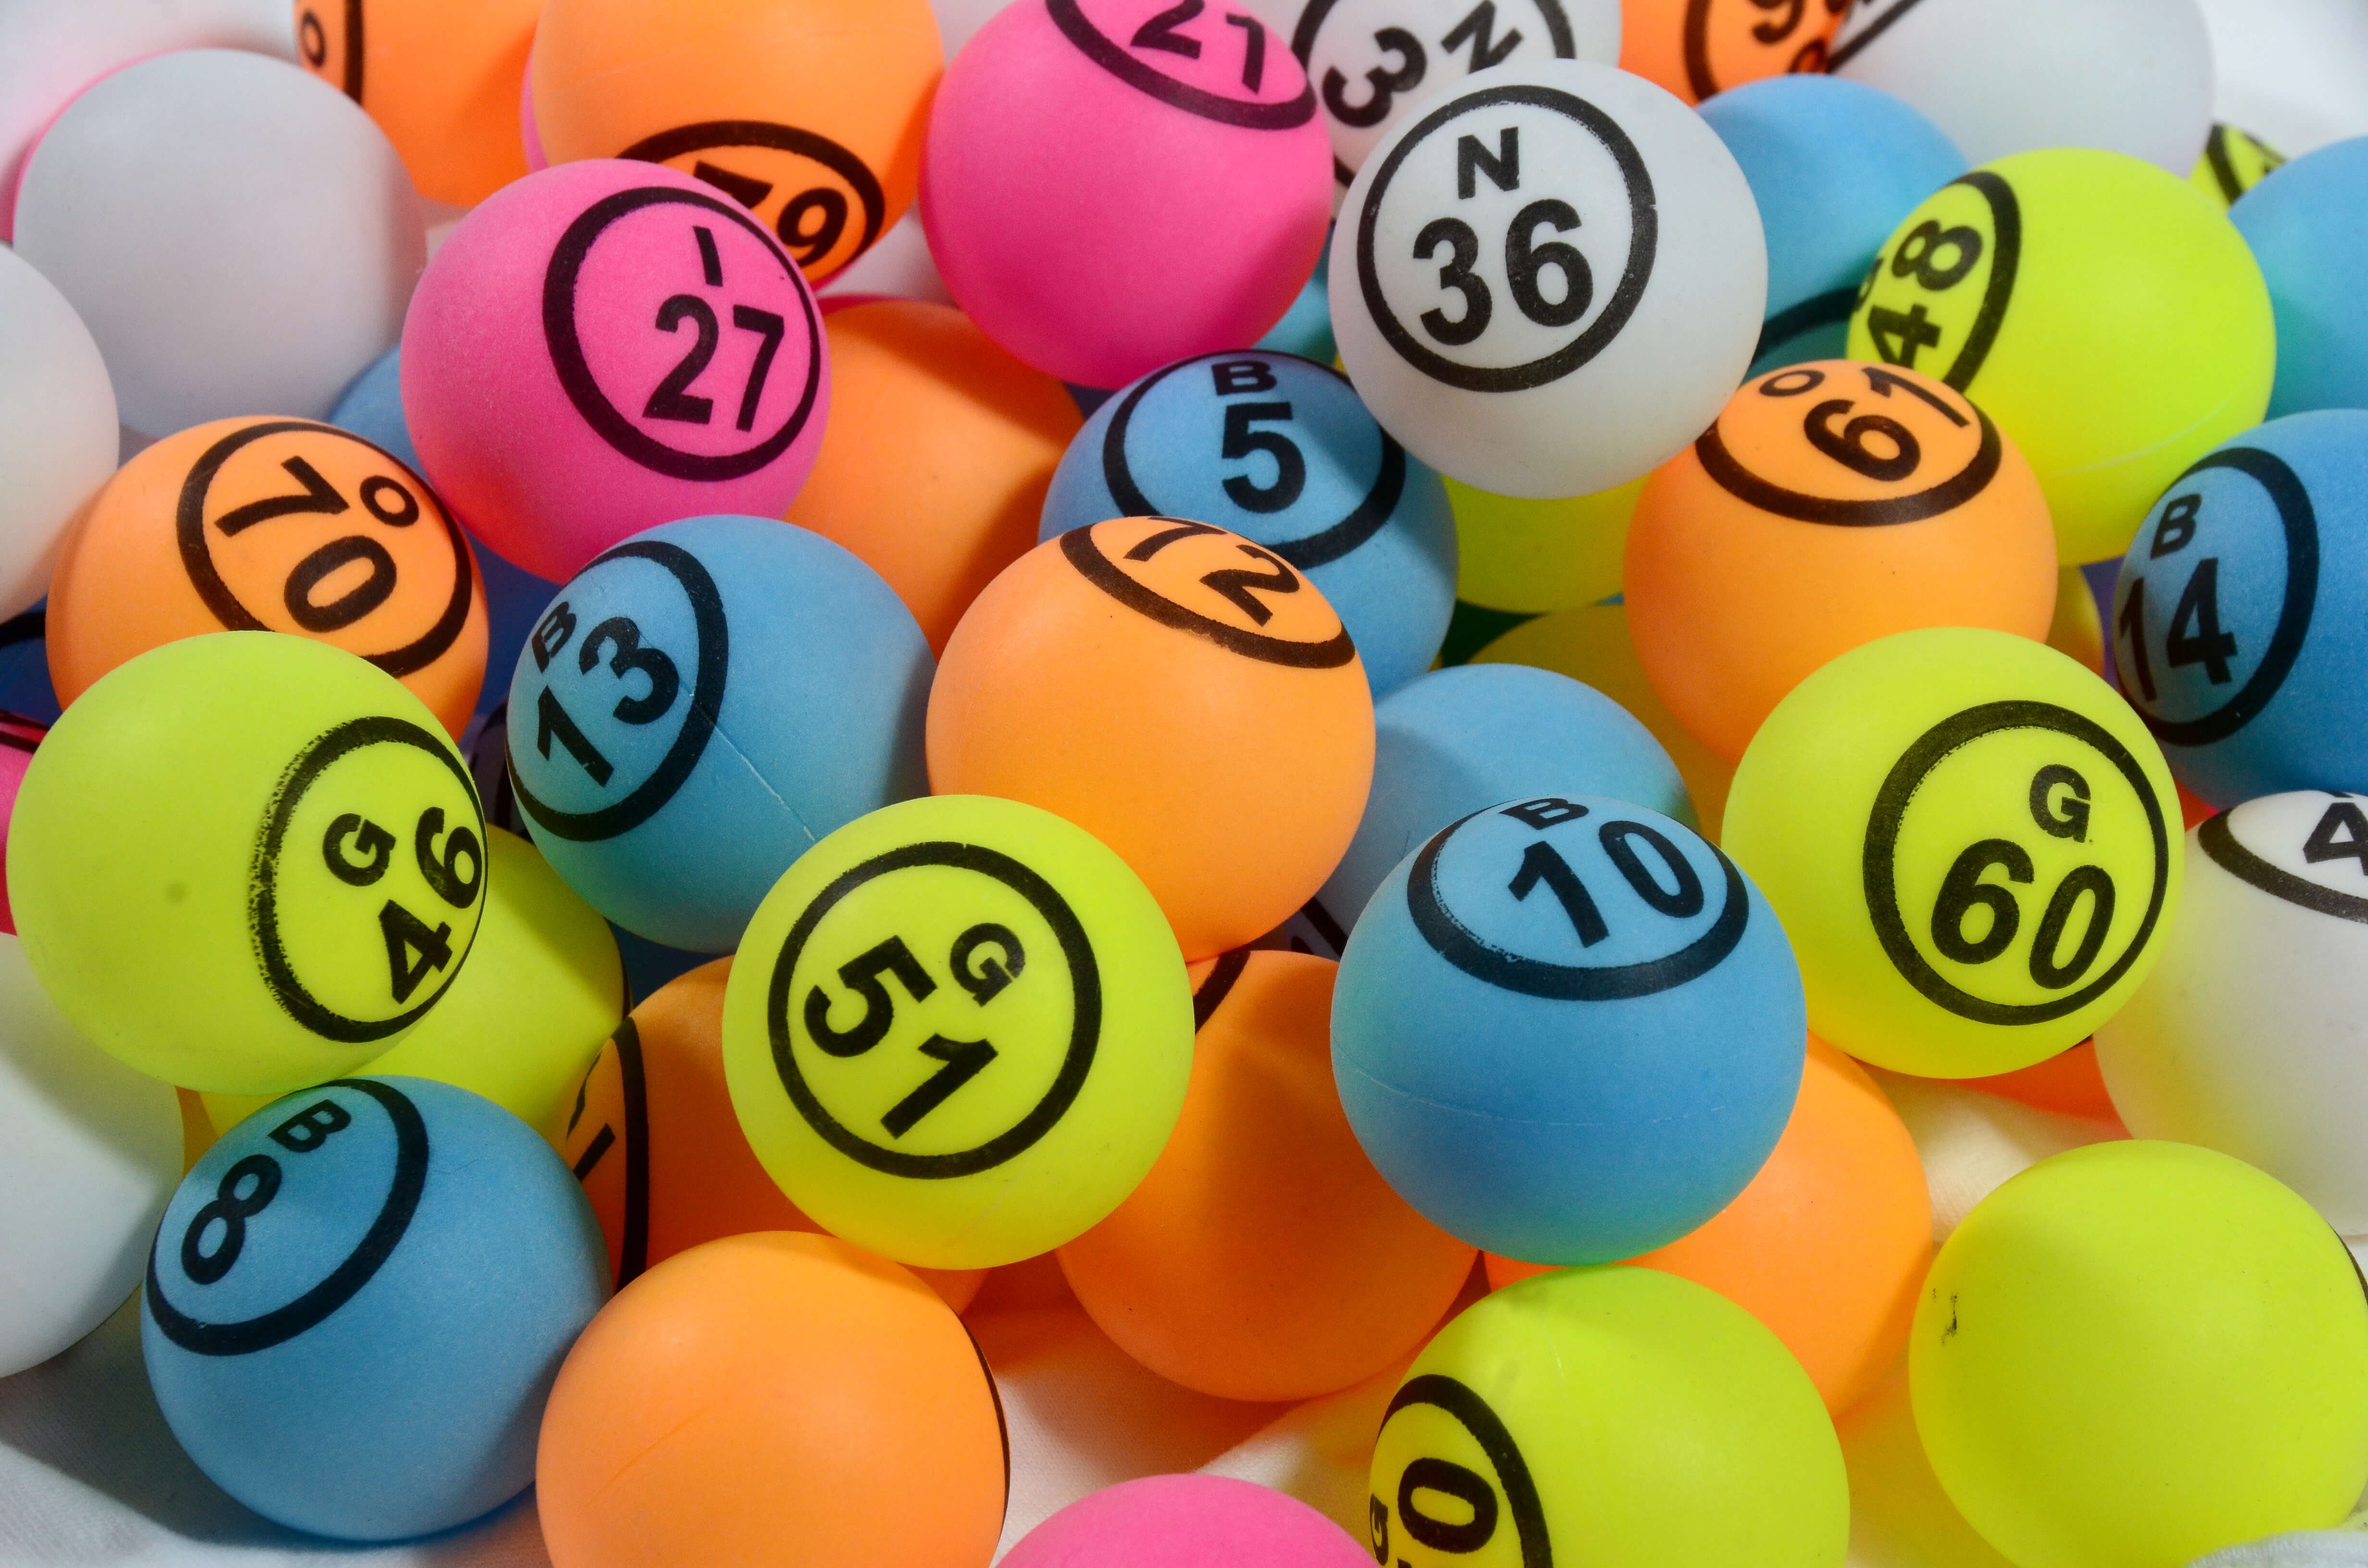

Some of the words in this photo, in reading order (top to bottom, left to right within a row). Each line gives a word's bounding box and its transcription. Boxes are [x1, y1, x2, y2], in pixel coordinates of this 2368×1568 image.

[1322, 27, 1427, 128] 3
[1441, 0, 1522, 74] N
[1458, 127, 1519, 199] N
[693, 227, 723, 287] I
[1413, 199, 1593, 346] 36
[1867, 220, 1982, 369] 48
[643, 294, 784, 432] 27
[1212, 360, 1277, 395] B
[1222, 401, 1306, 513] 5
[1804, 368, 1969, 481] 61
[215, 456, 397, 633] 70
[360, 476, 419, 527] O
[2149, 494, 2201, 560] B
[531, 601, 576, 673] B
[2120, 558, 2237, 701] 14
[537, 617, 679, 788] 13
[322, 813, 396, 886] G
[1499, 798, 1589, 830] B
[2029, 764, 2091, 843] G
[378, 807, 481, 1004] 46
[1508, 821, 1704, 947] 10
[1931, 839, 2115, 989] 60
[950, 923, 1025, 1006] G
[804, 936, 998, 1139] 51
[268, 1100, 351, 1153] B
[181, 1155, 282, 1285] 8
[1398, 1458, 1498, 1568] 0
